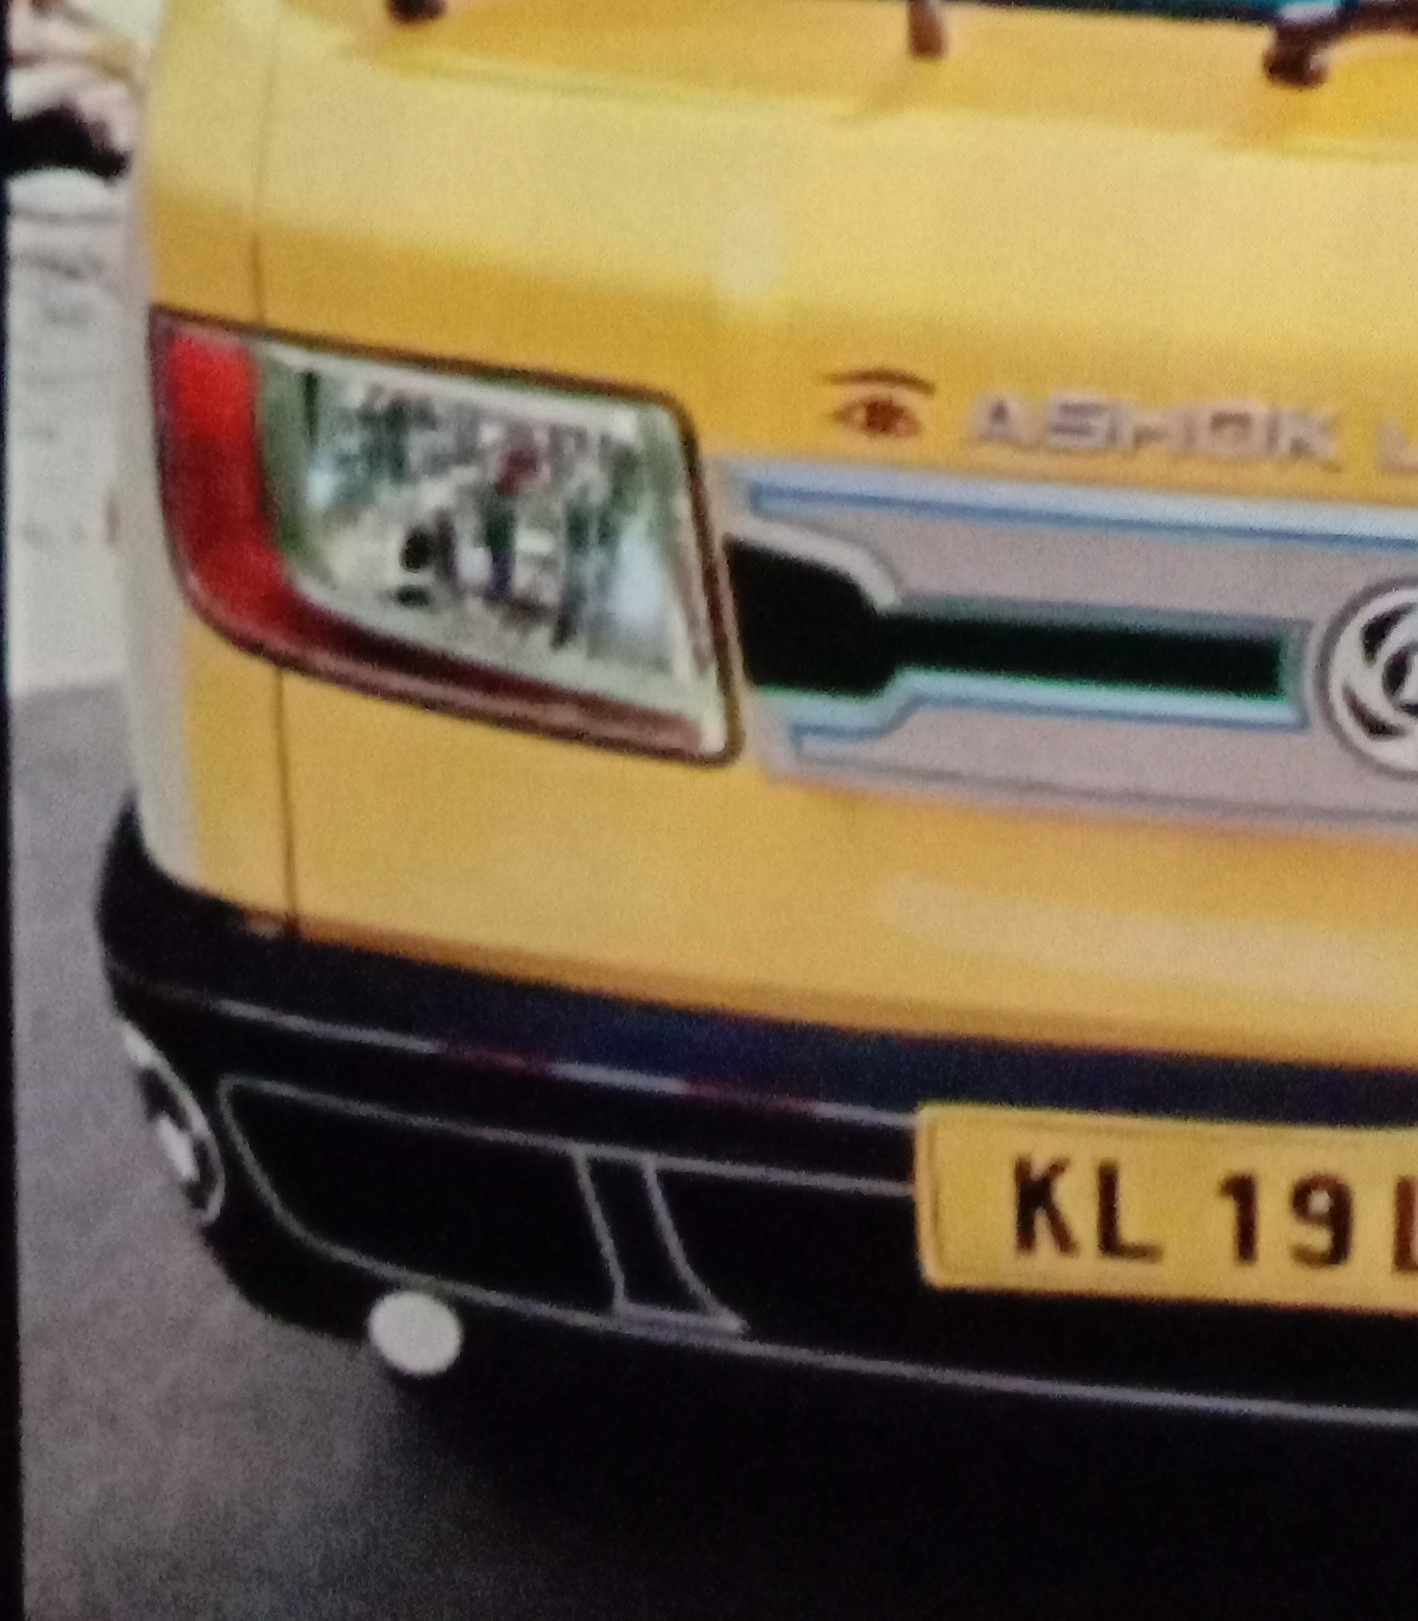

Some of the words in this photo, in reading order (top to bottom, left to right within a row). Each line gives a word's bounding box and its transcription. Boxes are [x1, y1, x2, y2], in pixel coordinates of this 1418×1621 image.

[972, 391, 1338, 467] ASHOK
[1012, 1151, 1164, 1266] KL
[1218, 1171, 1355, 1268] 19
